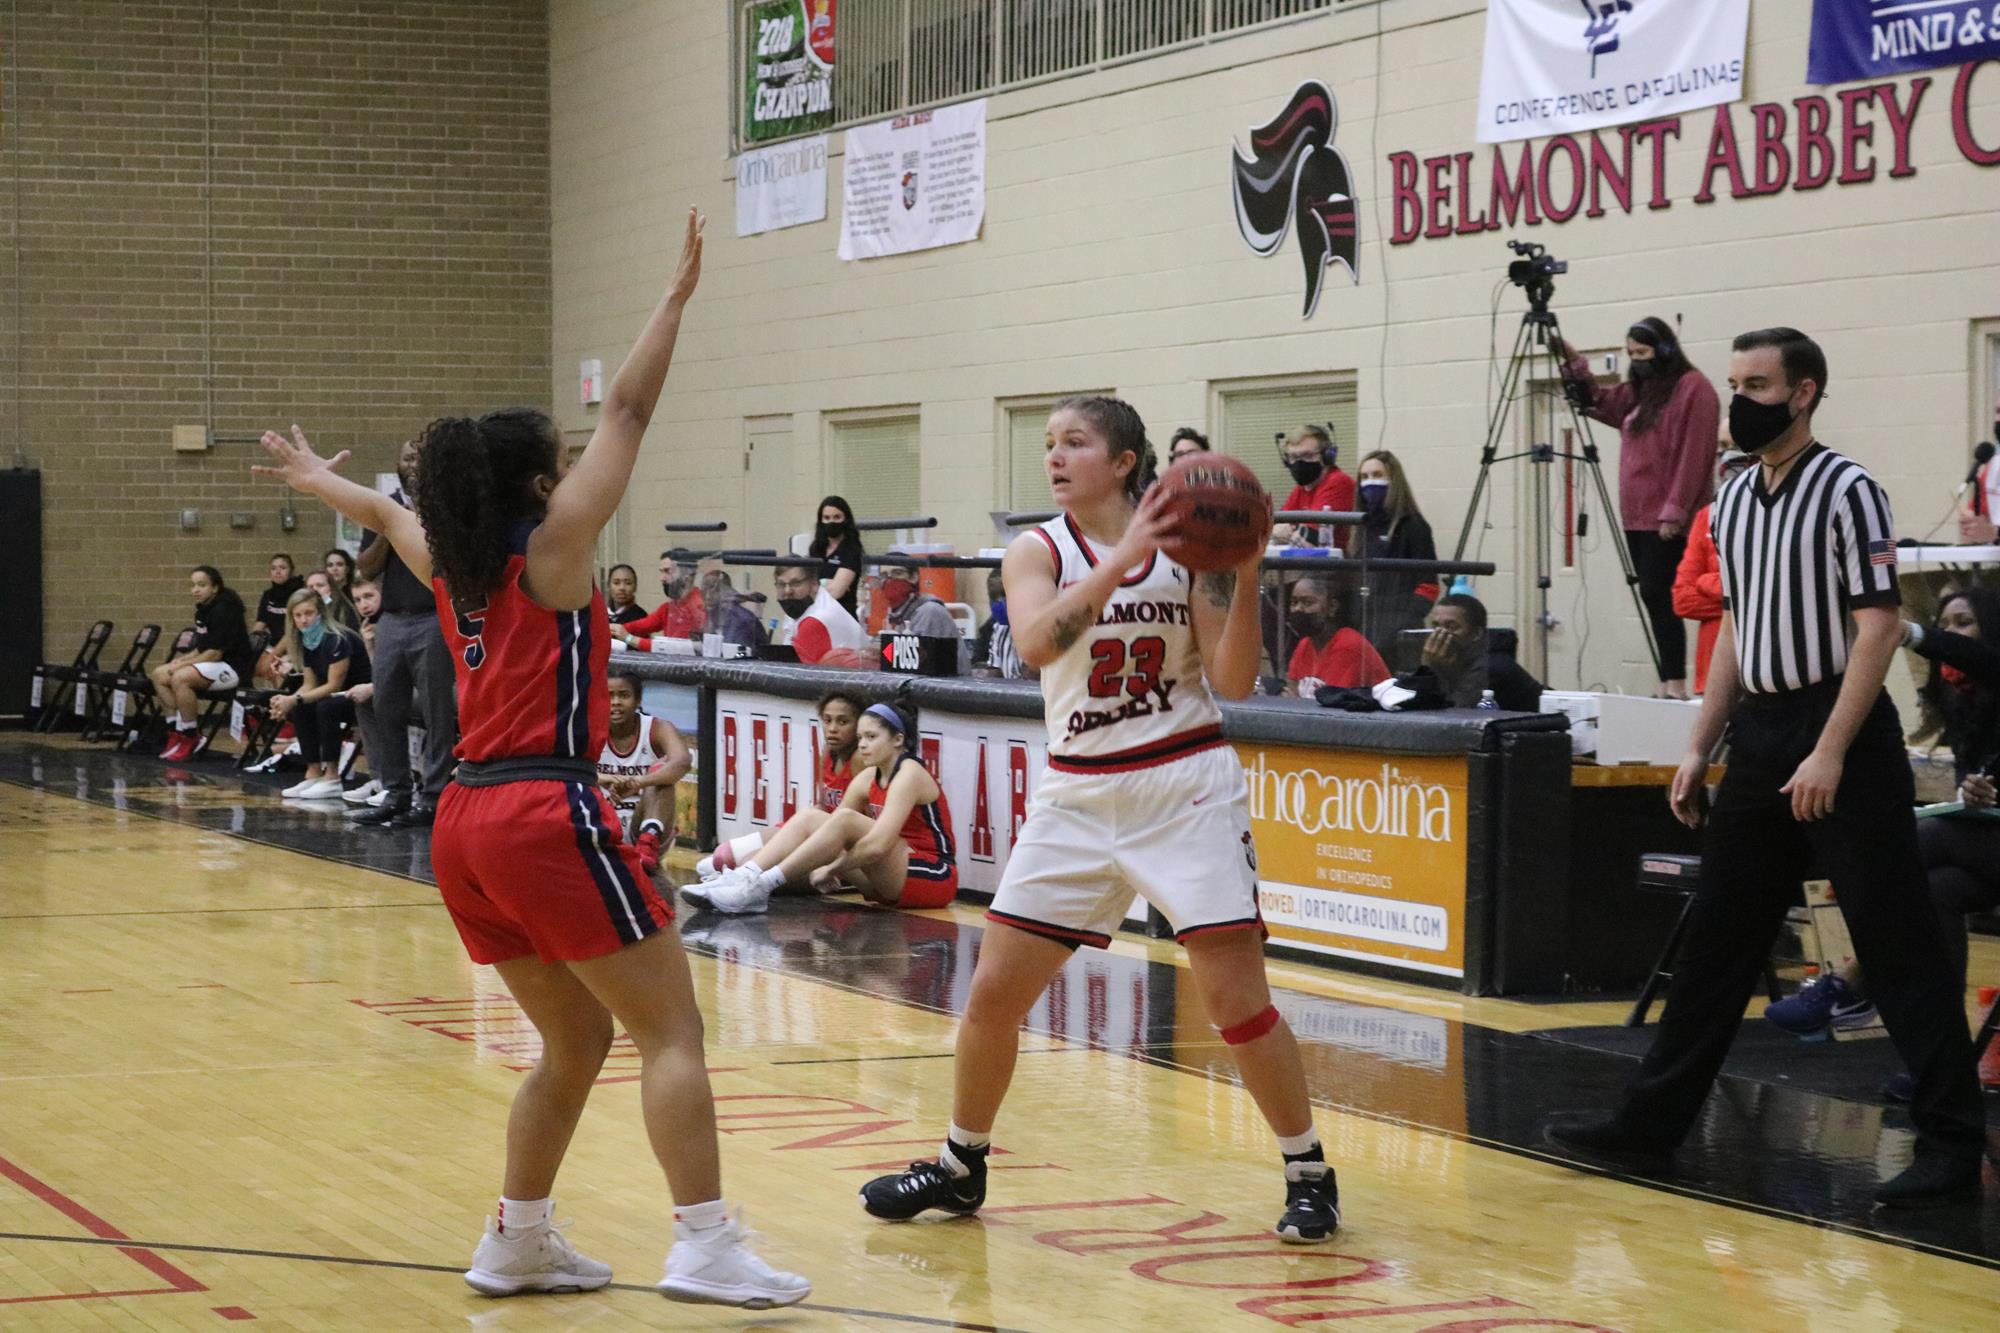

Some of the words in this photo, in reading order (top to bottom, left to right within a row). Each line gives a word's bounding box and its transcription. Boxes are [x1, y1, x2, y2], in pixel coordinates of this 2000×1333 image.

[1495, 88, 1618, 125] CONFERENCE
[1624, 60, 1741, 106] CAROLINAS
[1388, 116, 1681, 246] BELMONT
[1693, 76, 1932, 205] ABBEY
[1094, 600, 1190, 627] LMONT
[892, 635, 920, 670] POSS
[1087, 635, 1167, 698] 23
[1244, 752, 1452, 842] thoCarolina
[1316, 843, 1373, 863] EXCELLENCE
[1316, 866, 1328, 881] IN
[1330, 868, 1393, 889] ORTHOPEDICS
[1304, 897, 1441, 939] ORTHOCAROLINA.COM
